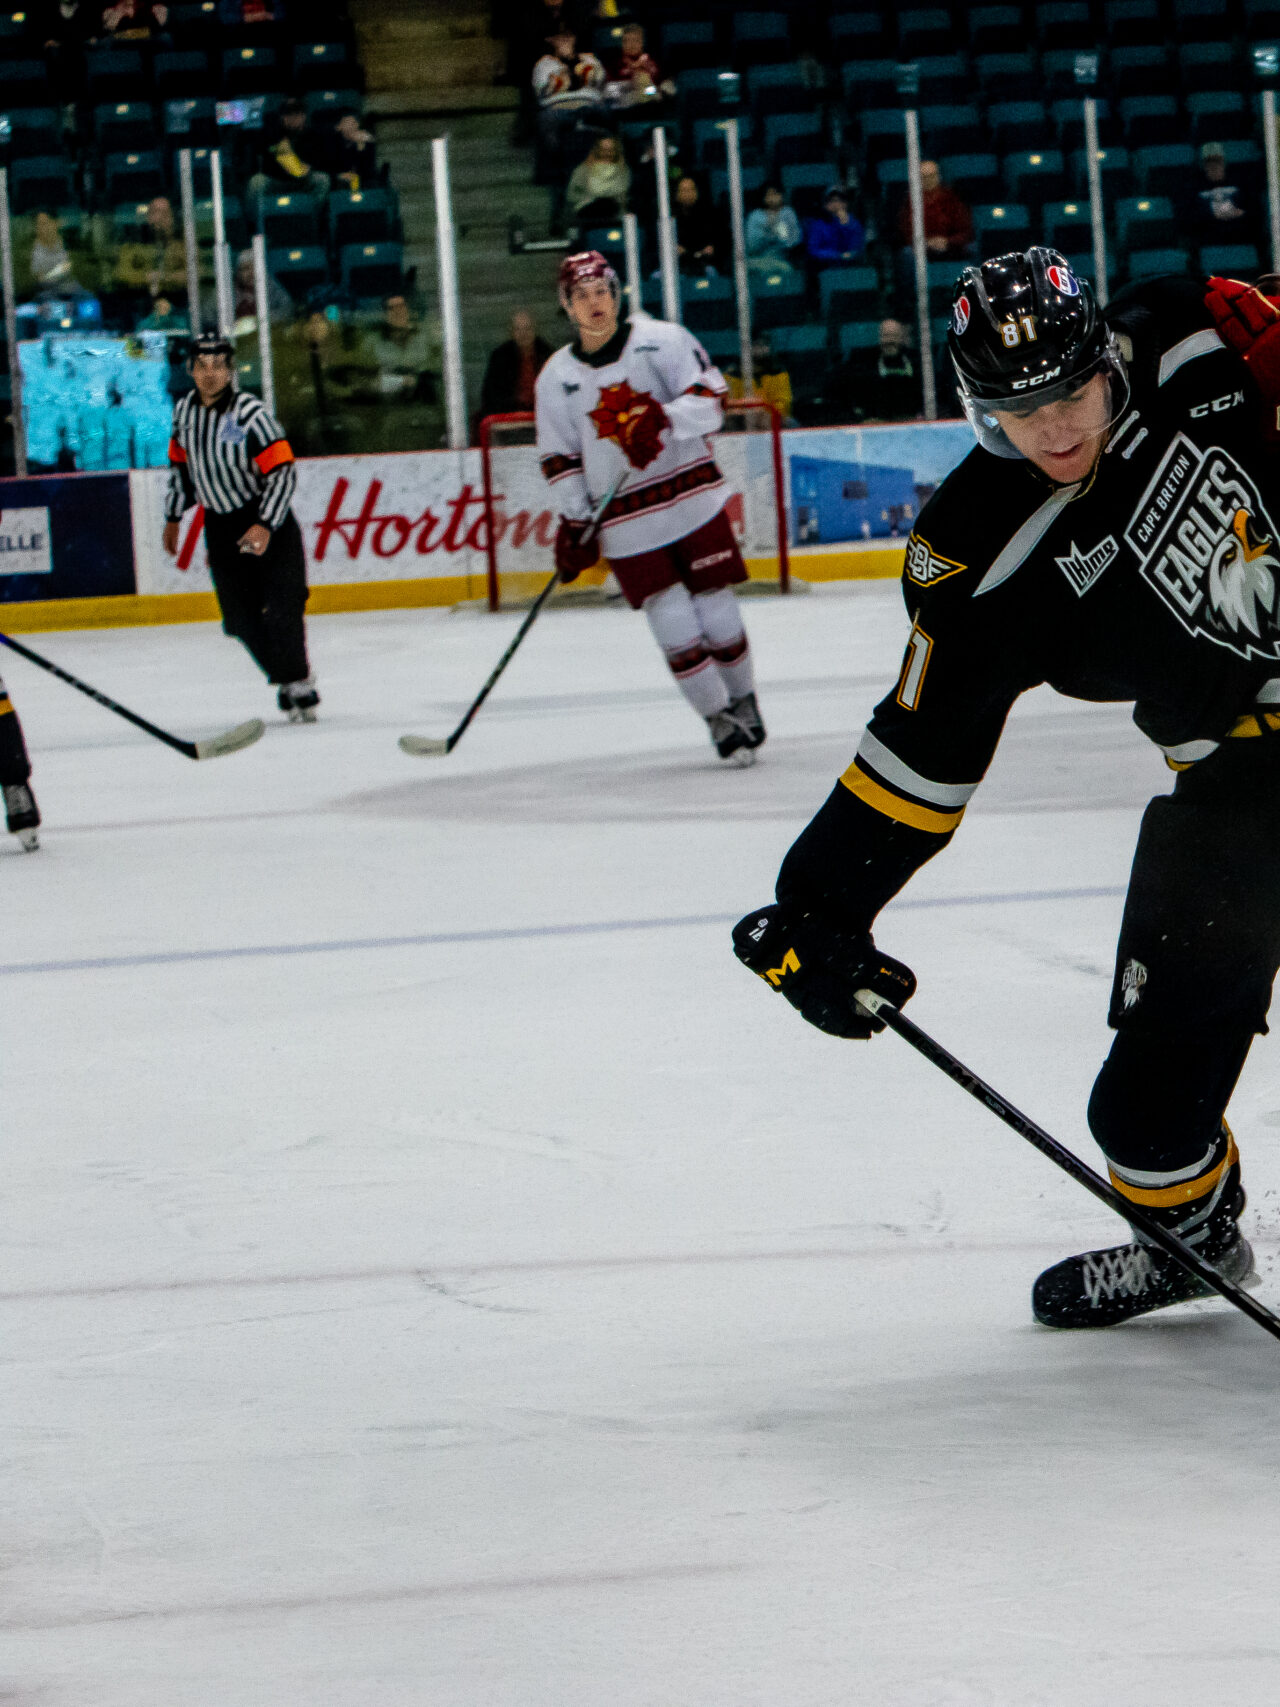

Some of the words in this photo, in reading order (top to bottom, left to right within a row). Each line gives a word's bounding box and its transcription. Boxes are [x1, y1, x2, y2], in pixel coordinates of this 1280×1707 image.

[1001, 315, 1038, 348] 81
[1012, 366, 1061, 391] CCM
[1188, 390, 1245, 418] CCM
[1136, 509, 1162, 543] CAPE
[1156, 453, 1191, 511] BRETON
[1153, 459, 1253, 617] EAGLES
